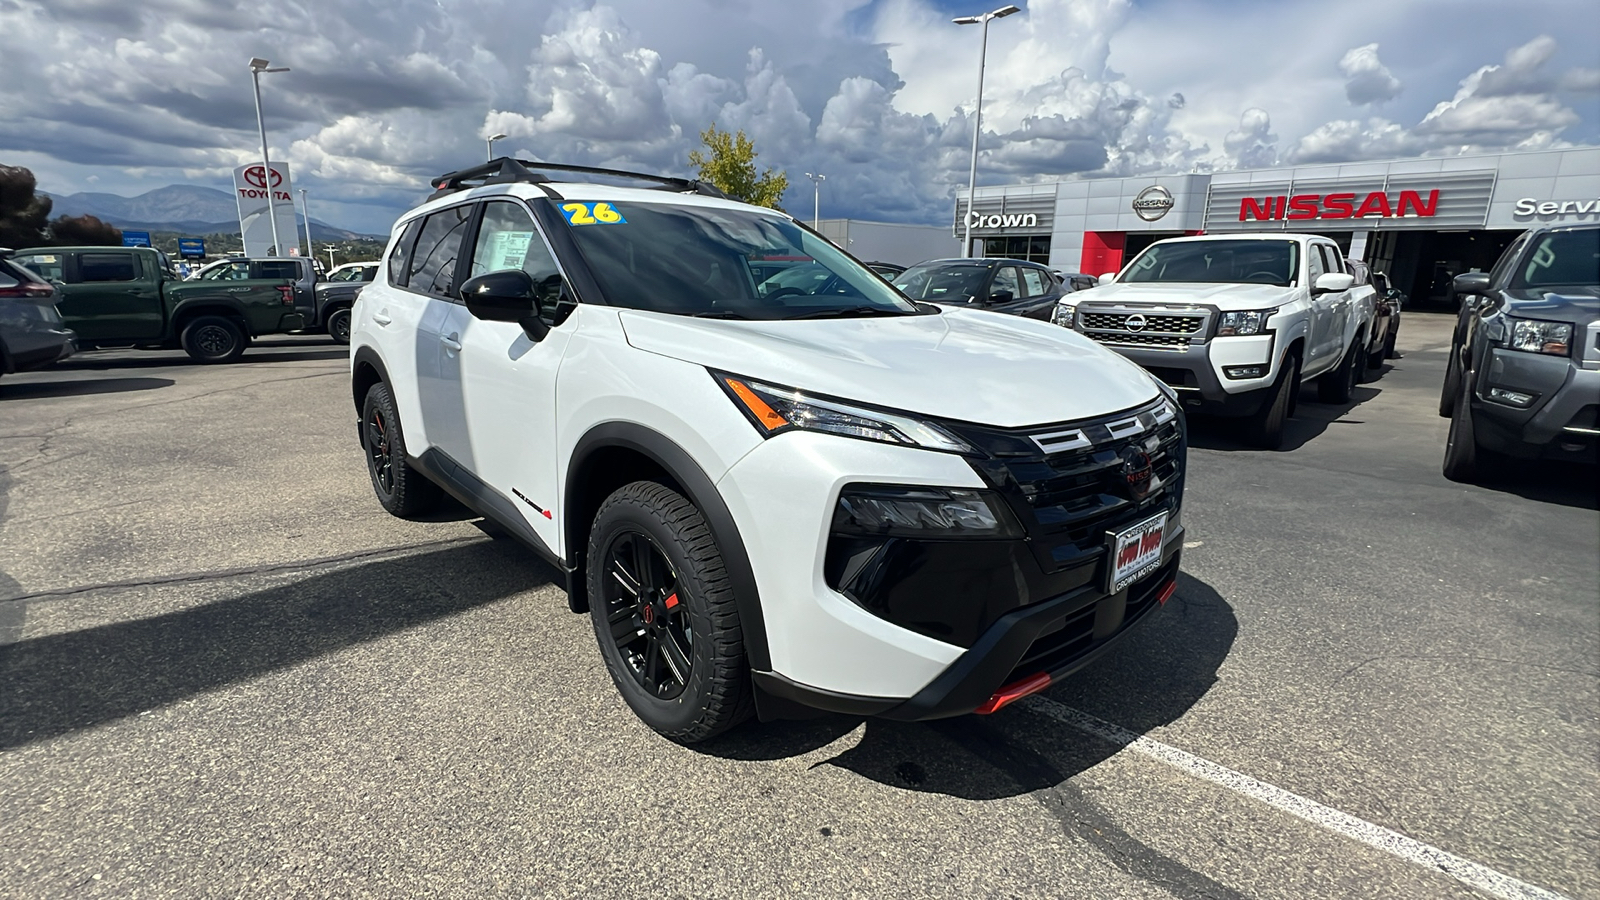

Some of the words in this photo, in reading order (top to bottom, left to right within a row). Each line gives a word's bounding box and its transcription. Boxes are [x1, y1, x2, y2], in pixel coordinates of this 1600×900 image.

[562, 203, 622, 225] 26
[1135, 200, 1170, 208] NISSAN
[1239, 189, 1440, 221] NISSAN
[964, 211, 1037, 229] Crown
[1116, 573, 1137, 592] CROWN
[1137, 559, 1161, 578] MOTORS
